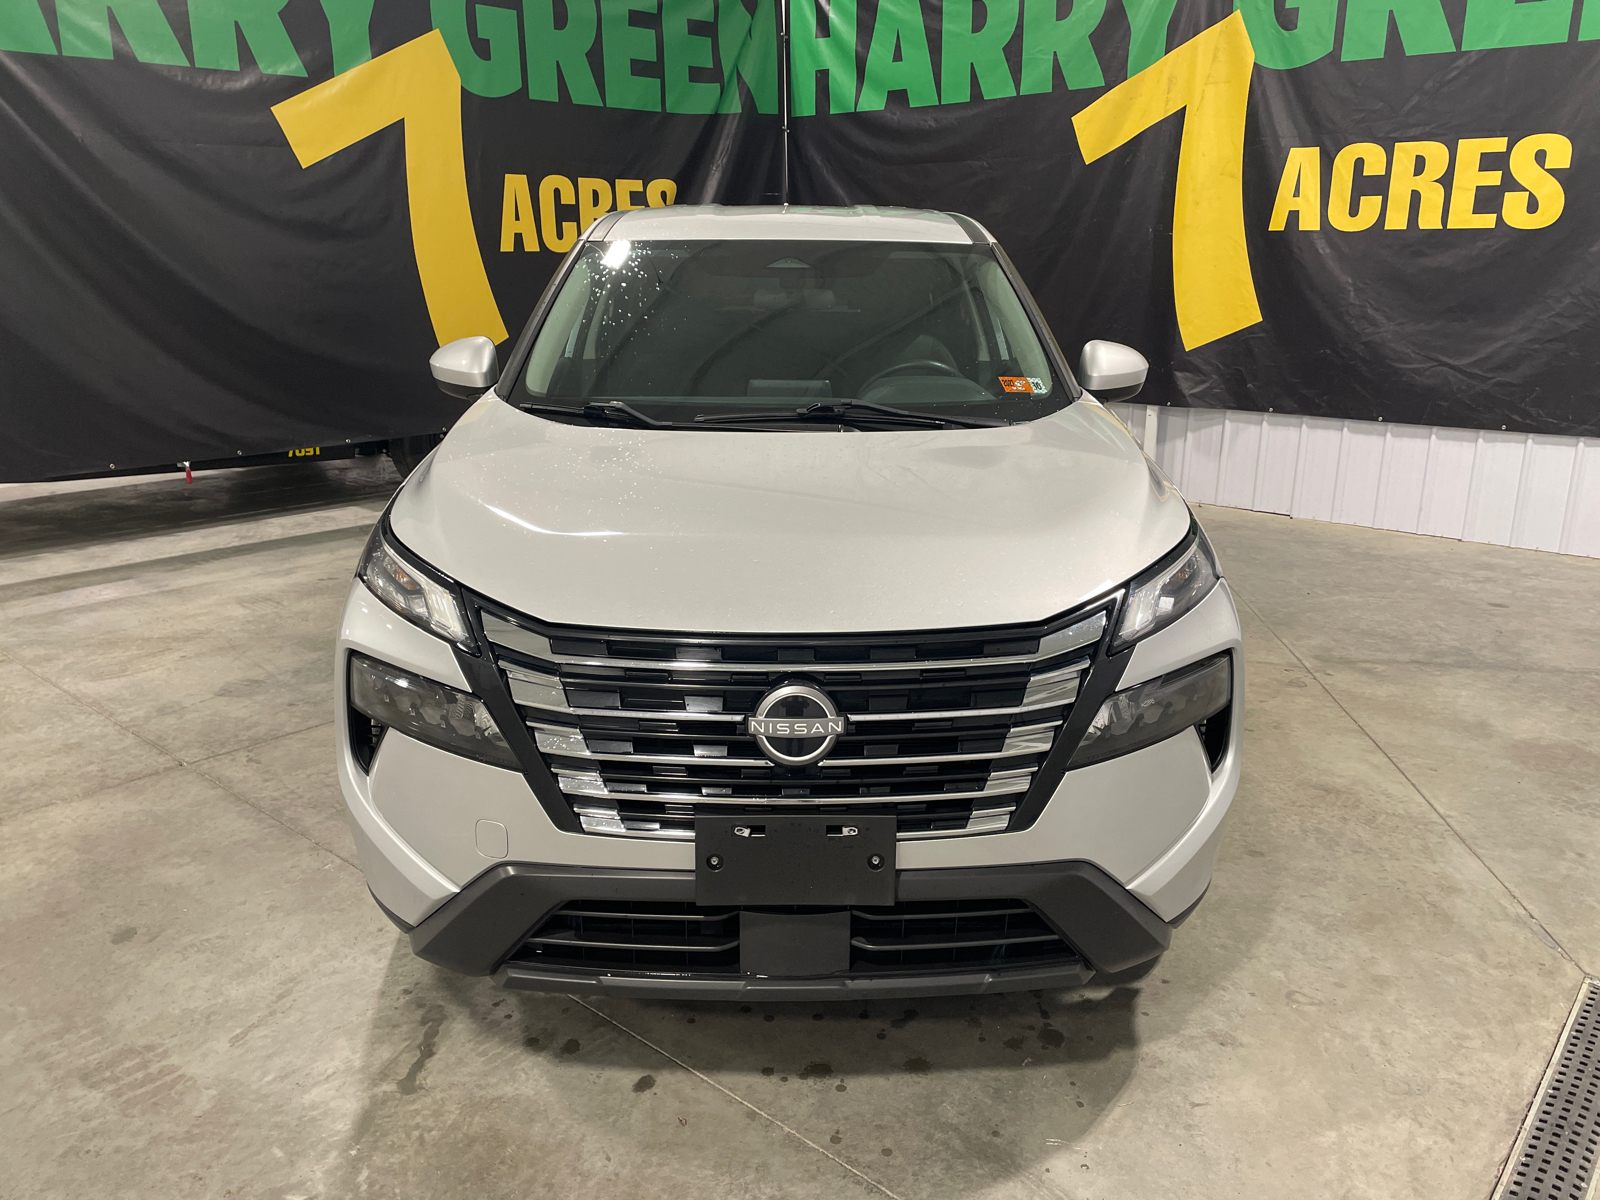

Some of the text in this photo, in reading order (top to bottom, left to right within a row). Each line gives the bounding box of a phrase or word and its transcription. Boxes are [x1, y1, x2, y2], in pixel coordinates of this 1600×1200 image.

[431, 0, 779, 115] GREEN
[791, 0, 1176, 117] HARRY
[270, 28, 509, 347] 7
[1071, 9, 1573, 351] 7 ACRES
[751, 721, 842, 735] NISSAN
